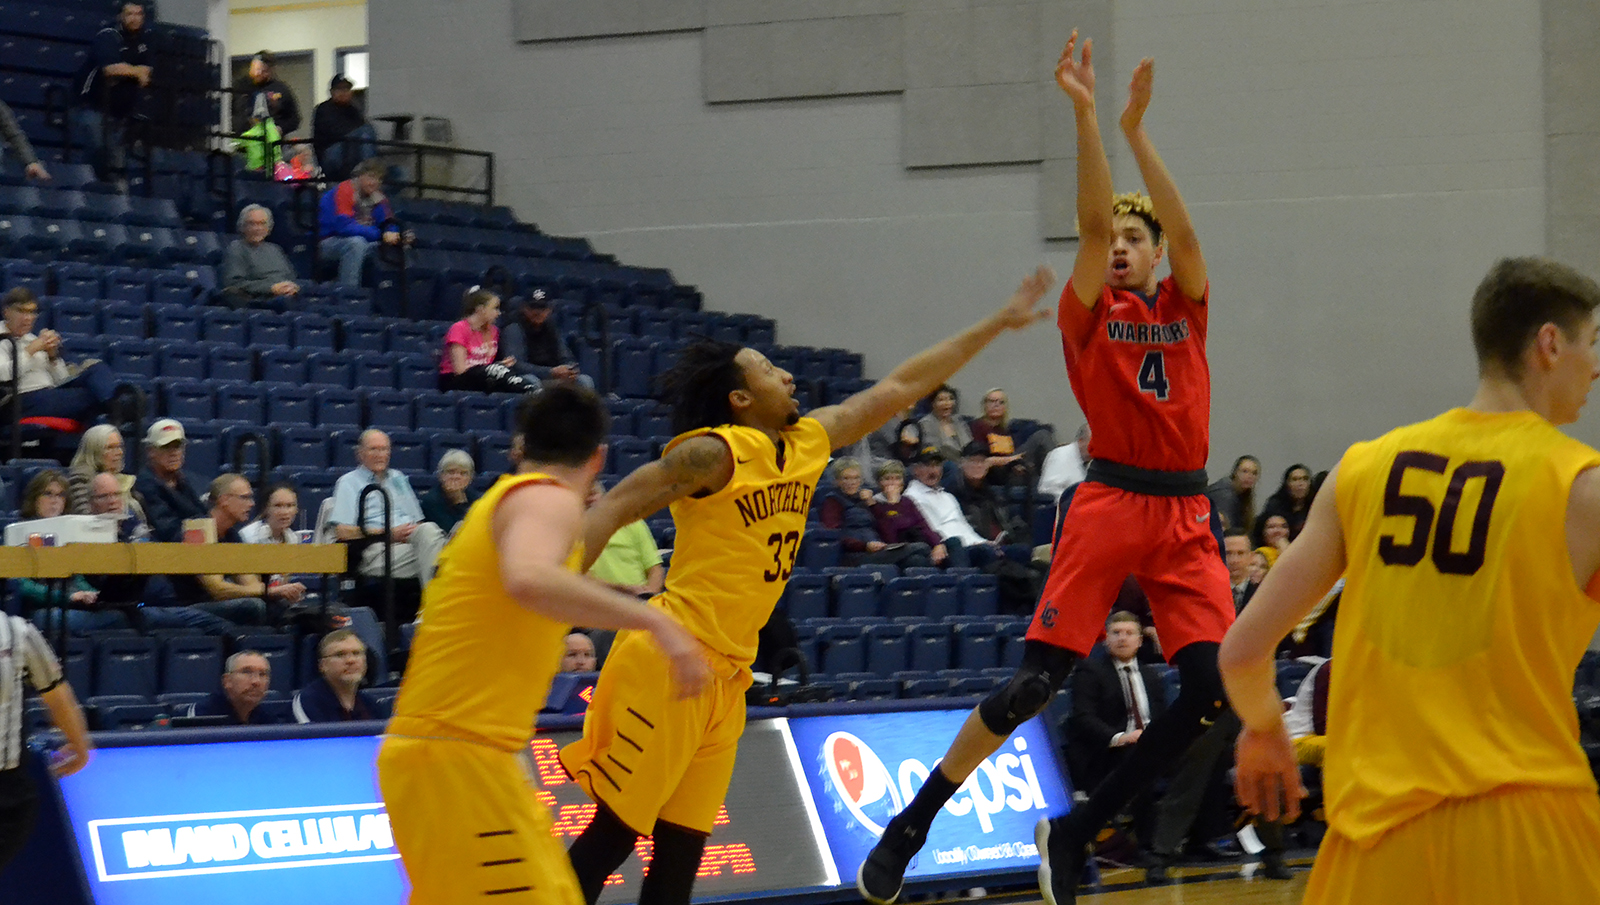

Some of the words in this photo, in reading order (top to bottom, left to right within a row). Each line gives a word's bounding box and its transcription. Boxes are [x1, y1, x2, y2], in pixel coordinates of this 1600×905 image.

[1107, 318, 1189, 343] WARRORS
[1137, 350, 1170, 401] 4
[1379, 449, 1506, 576] 50
[764, 530, 799, 582] 33
